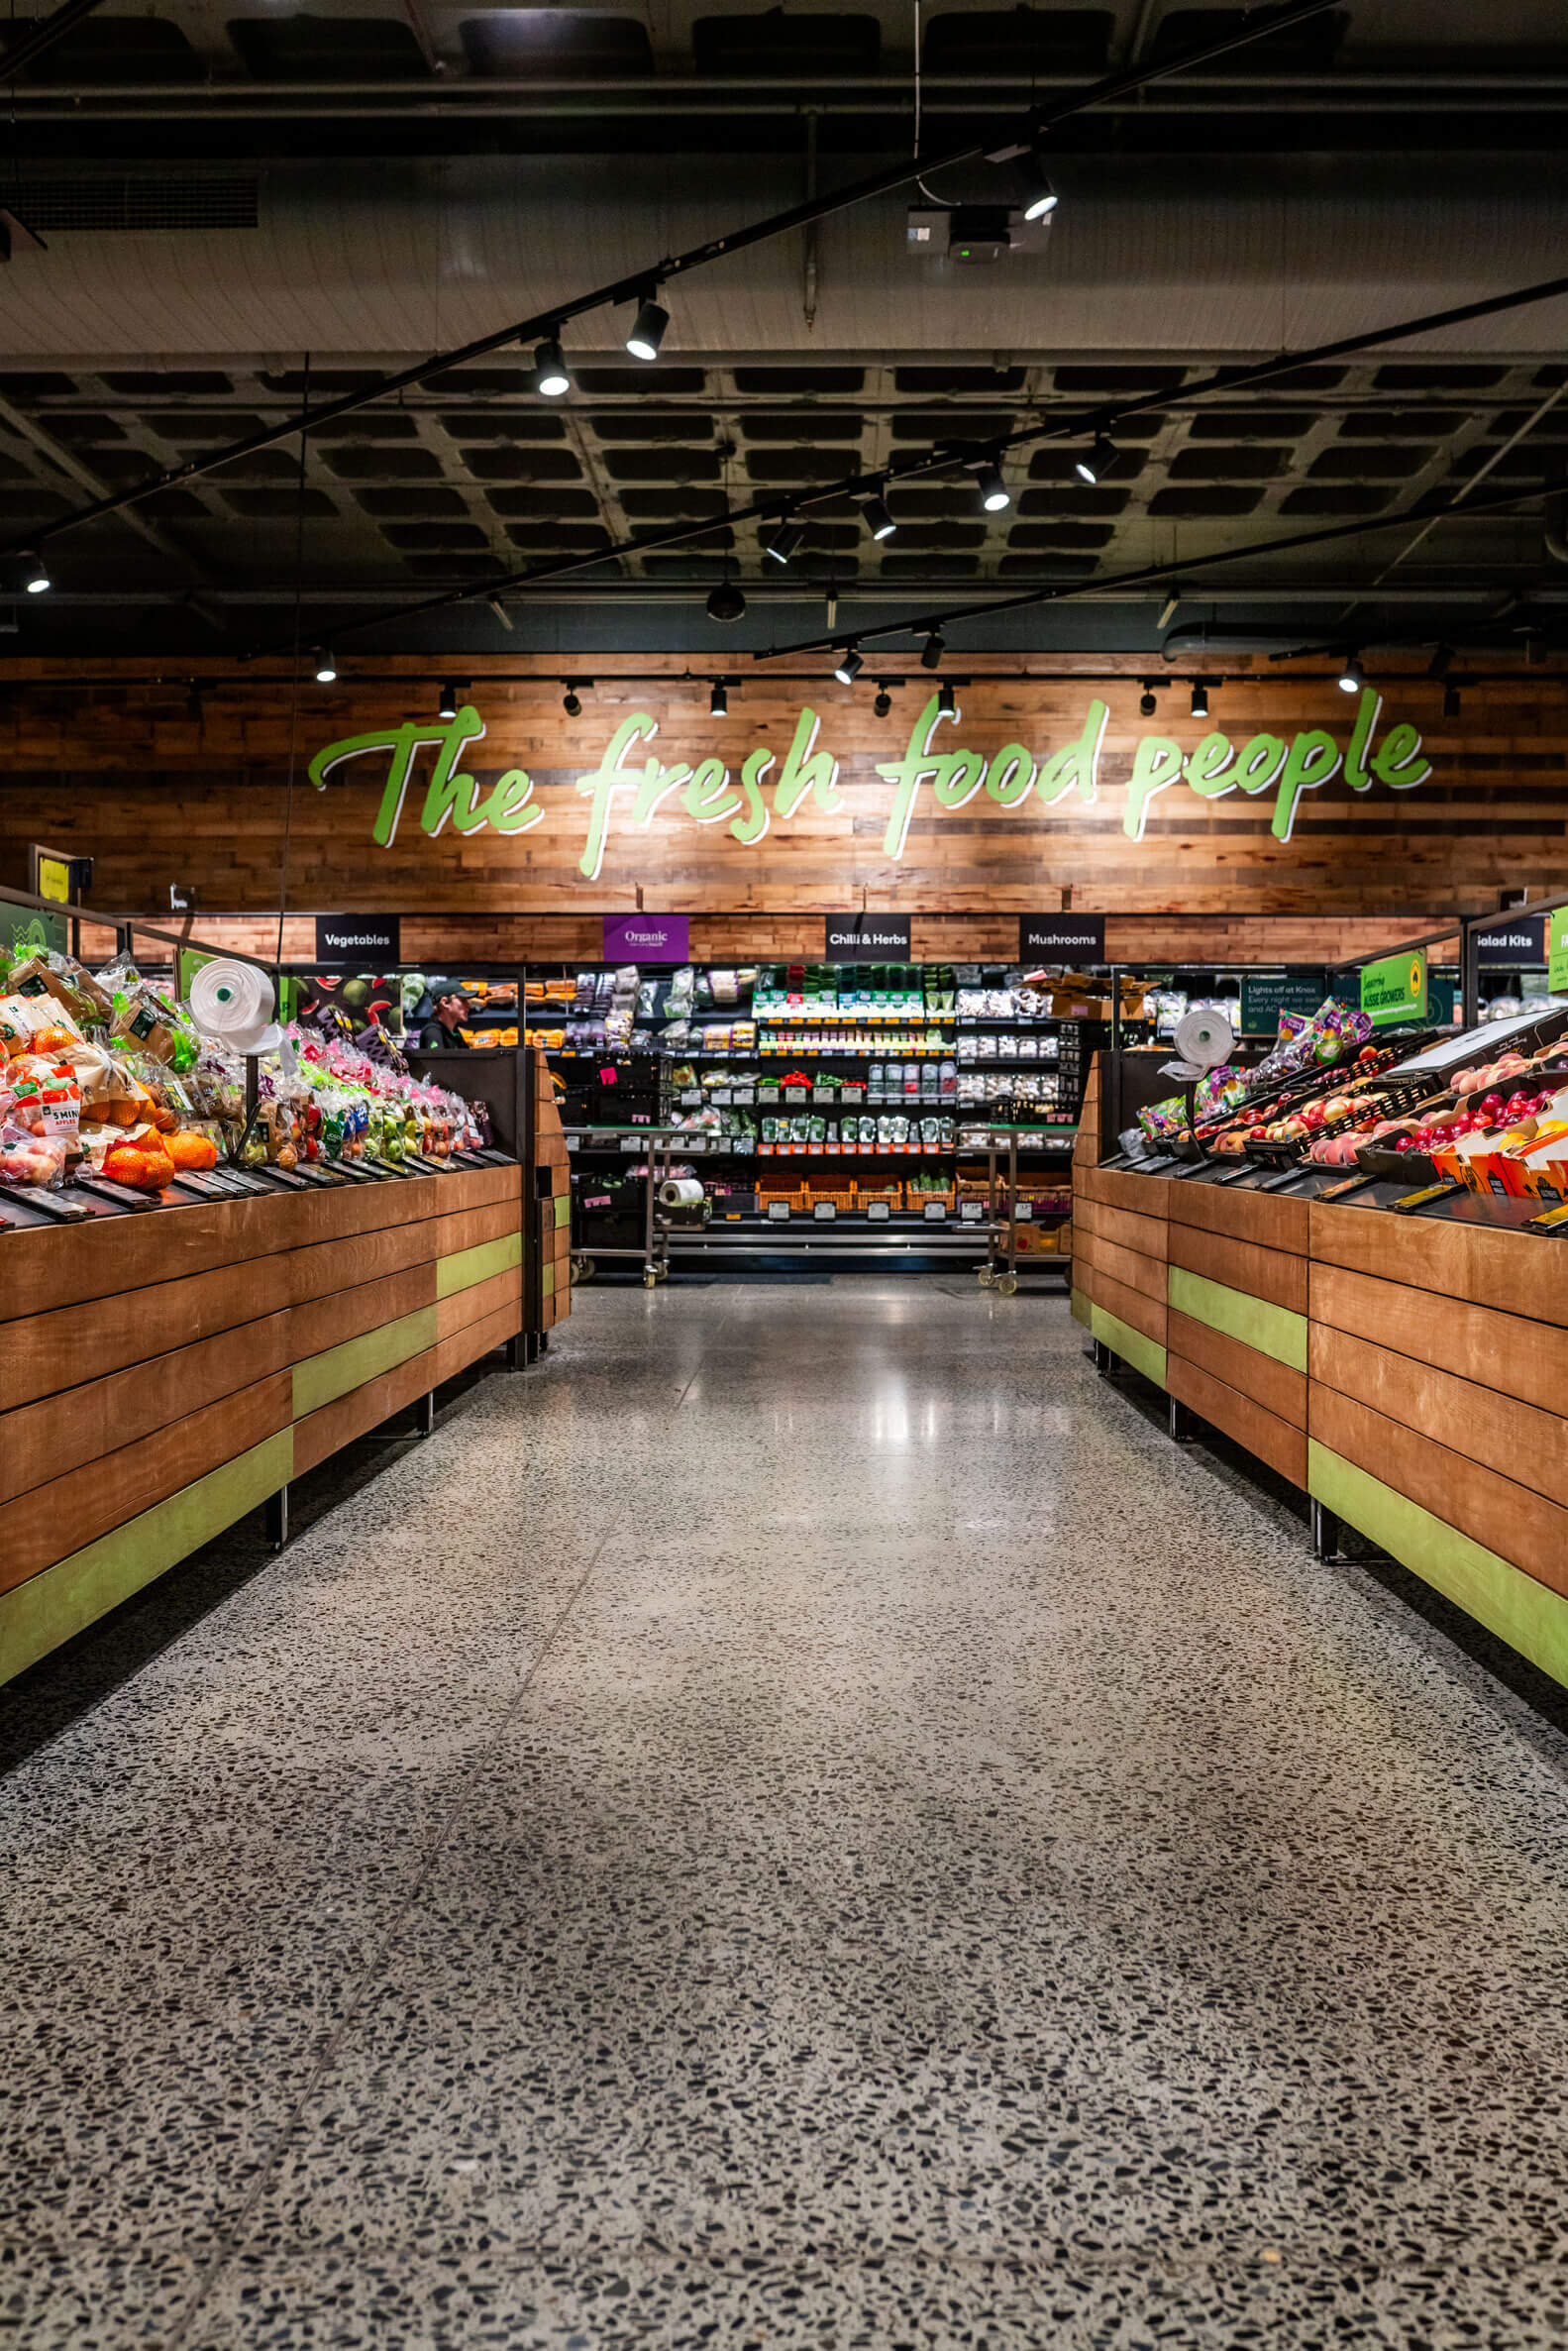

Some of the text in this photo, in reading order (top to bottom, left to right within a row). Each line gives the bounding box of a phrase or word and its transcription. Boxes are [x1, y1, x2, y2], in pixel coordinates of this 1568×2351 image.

[308, 687, 1432, 880] The fresh food people
[325, 934, 390, 948] Vegetables
[625, 930, 669, 943] Organic
[830, 933, 907, 945] Chilli & Herbs
[1028, 933, 1097, 945] Mushrooms
[1509, 934, 1532, 947] Kits
[1248, 986, 1273, 996] Lights
